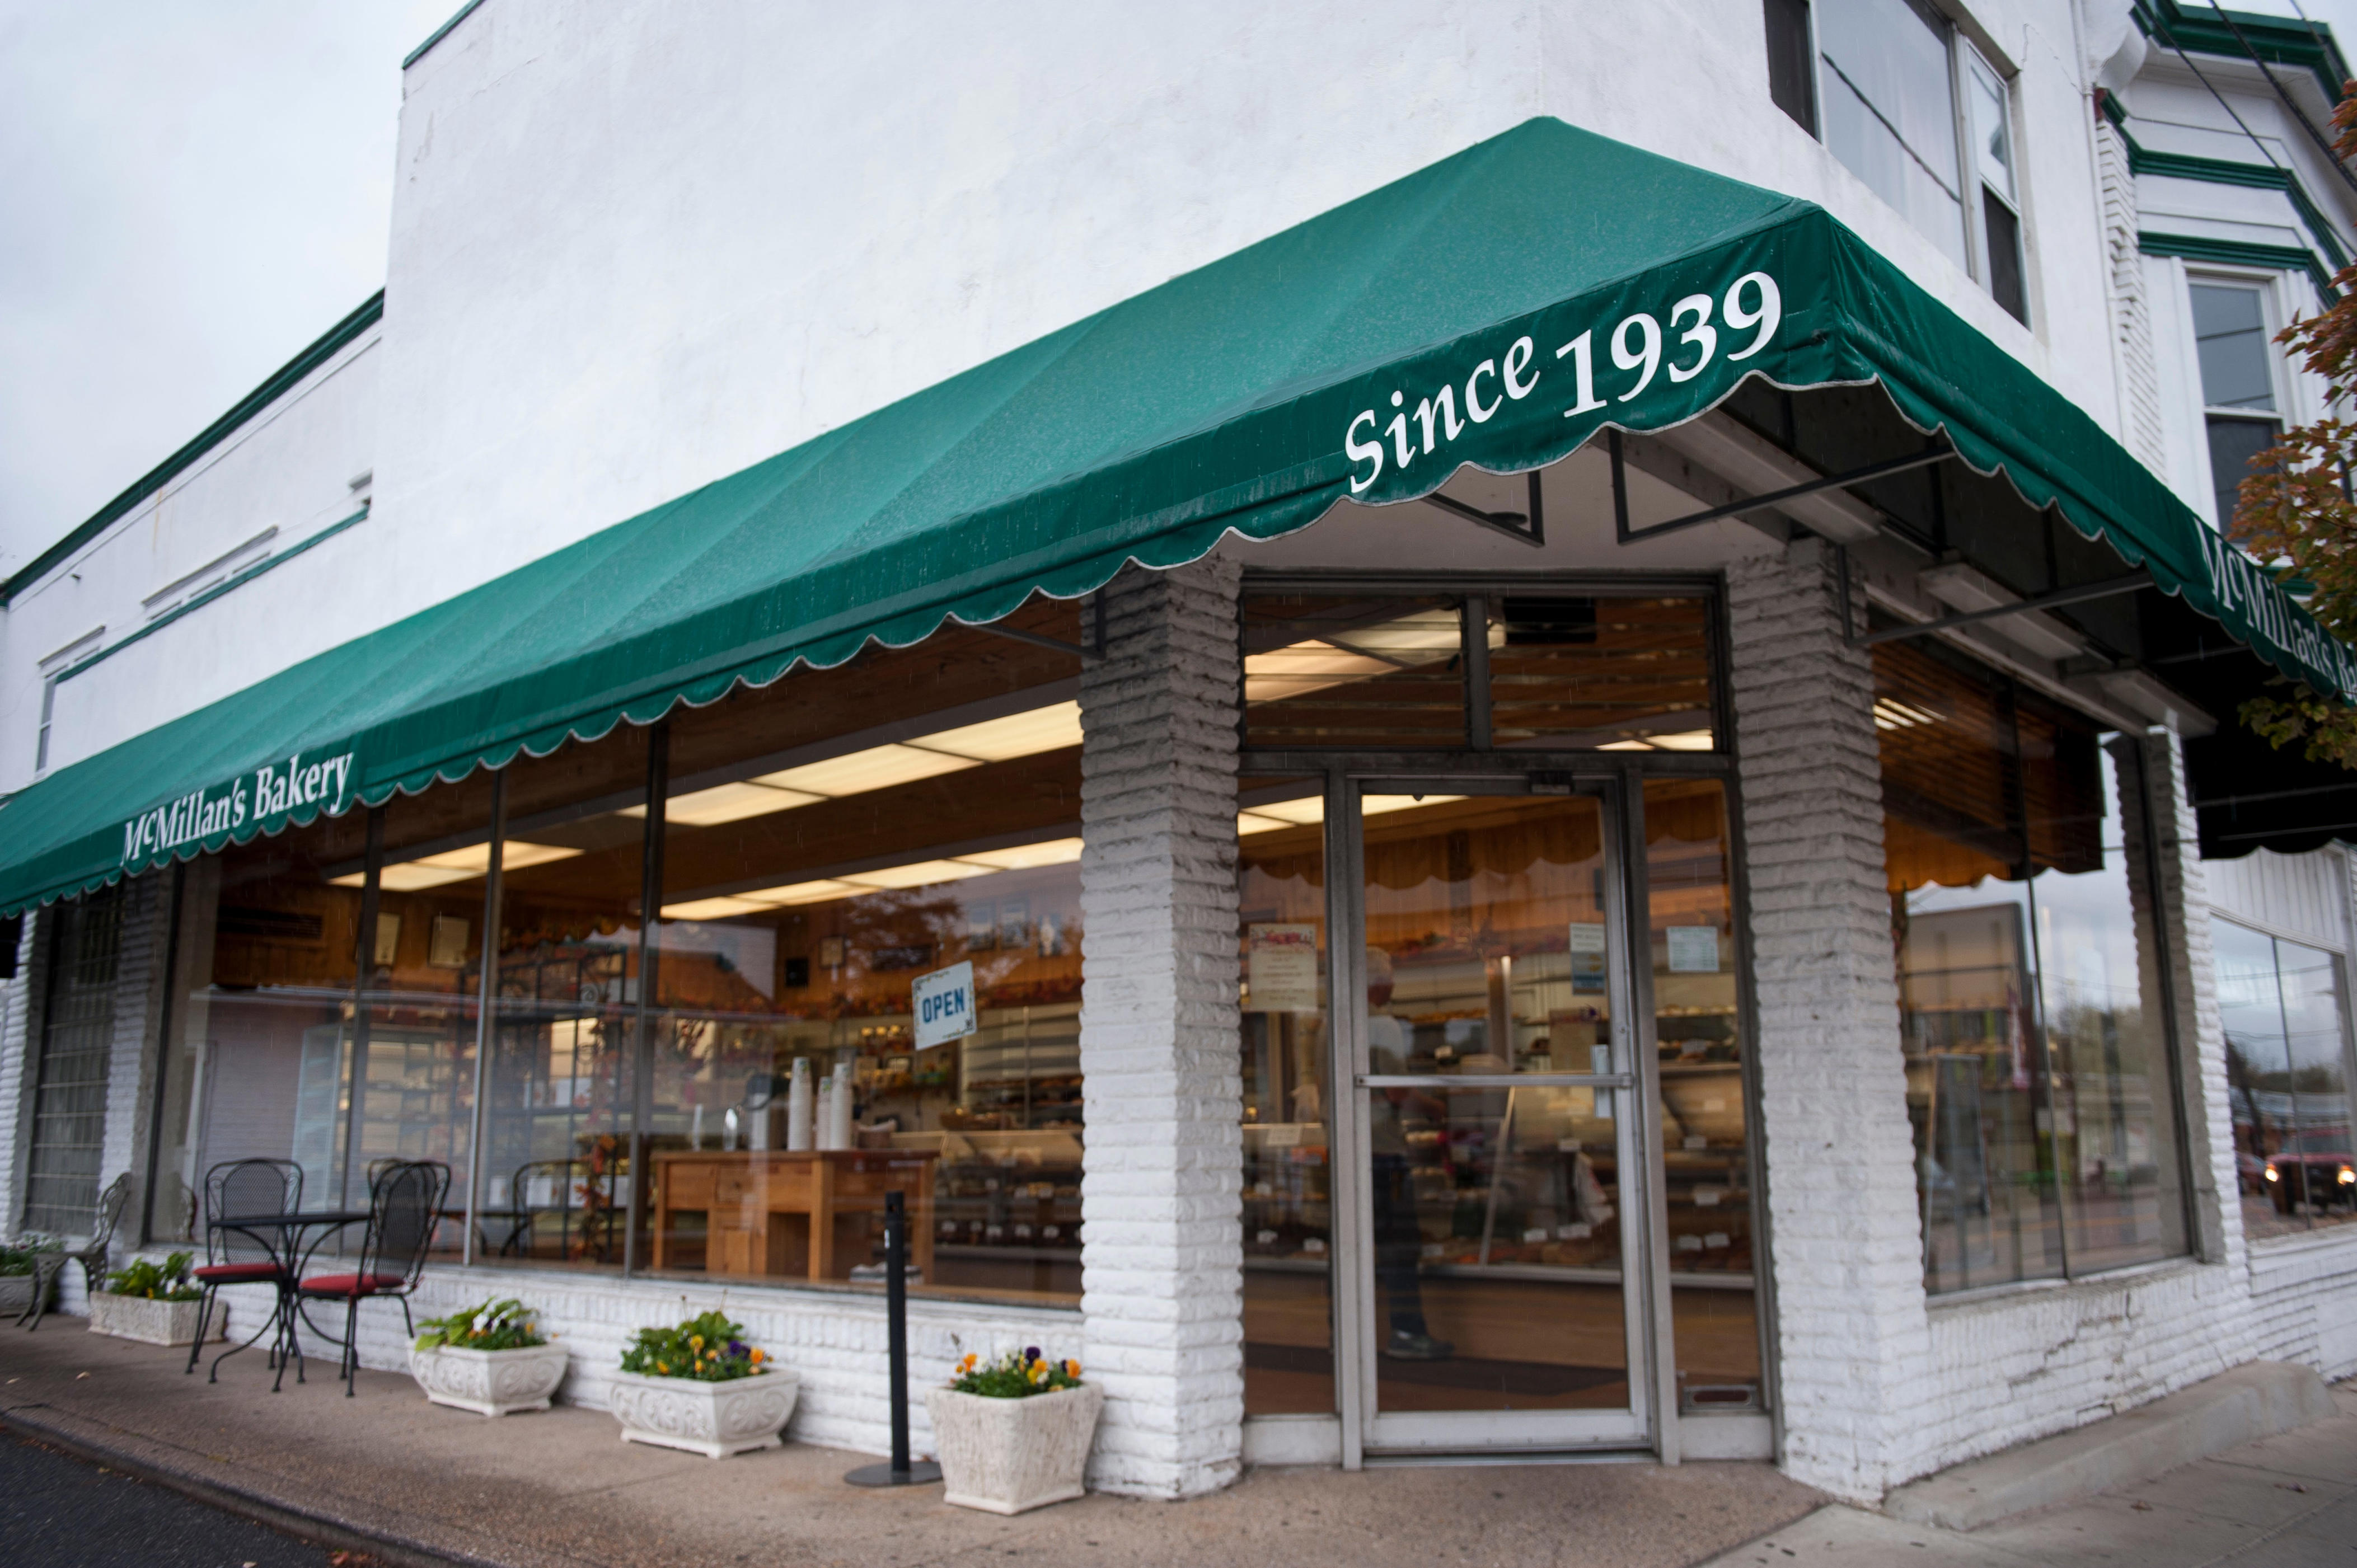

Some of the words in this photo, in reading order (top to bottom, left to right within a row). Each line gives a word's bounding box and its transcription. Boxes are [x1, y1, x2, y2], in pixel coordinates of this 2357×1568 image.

[1344, 335, 1540, 494] Since
[1555, 271, 1782, 418] 1939
[2331, 635, 2357, 705] Ba
[119, 777, 246, 867] McMillan's
[252, 752, 354, 820] Bakery
[922, 986, 966, 1024] OPEN
